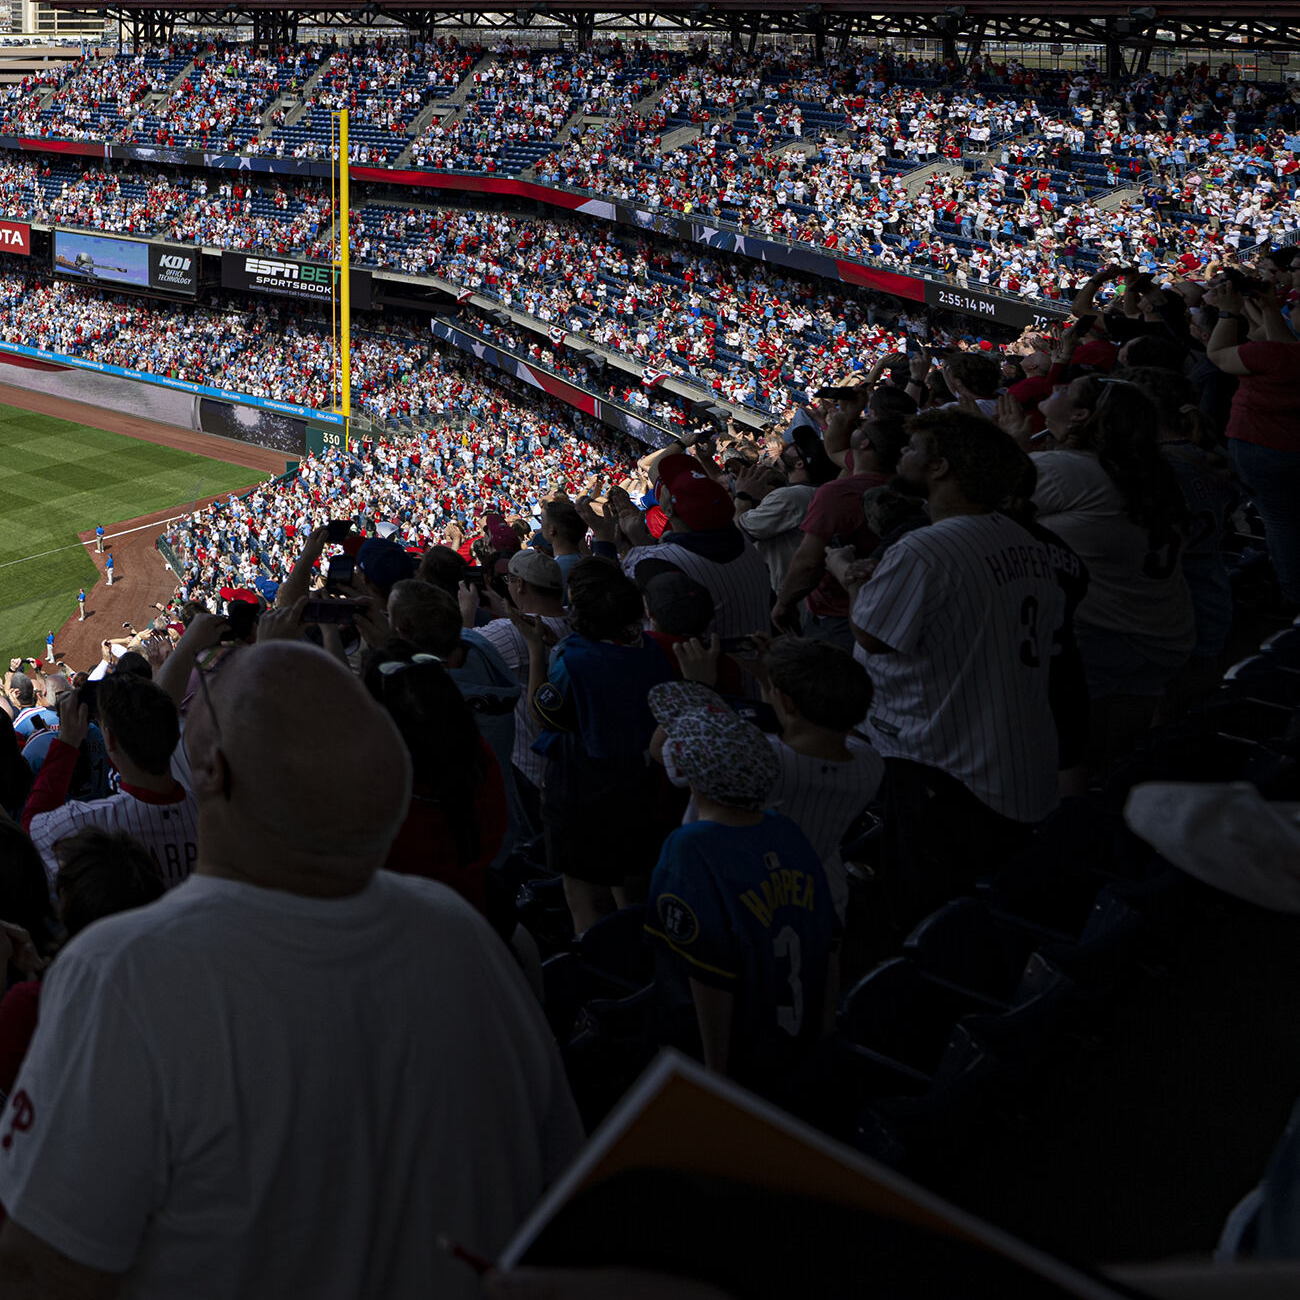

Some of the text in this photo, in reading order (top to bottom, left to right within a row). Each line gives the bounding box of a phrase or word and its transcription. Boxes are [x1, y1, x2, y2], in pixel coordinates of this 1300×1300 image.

[159, 254, 191, 271] KDI
[165, 269, 184, 278] OFFICE
[245, 258, 341, 285] ESPN BET
[158, 274, 192, 285] TECHNOLOGY
[256, 276, 332, 294] SPORTSBOOK
[938, 290, 996, 317] 2:55:14 PM
[71, 358, 99, 368] Independence
[163, 378, 193, 390] Independence
[221, 391, 240, 400] ibx.com
[263, 400, 298, 413] Independence
[316, 412, 338, 422] ibx.com
[322, 432, 340, 445] 330
[1020, 595, 1040, 668] 3
[739, 870, 816, 928] HARPER
